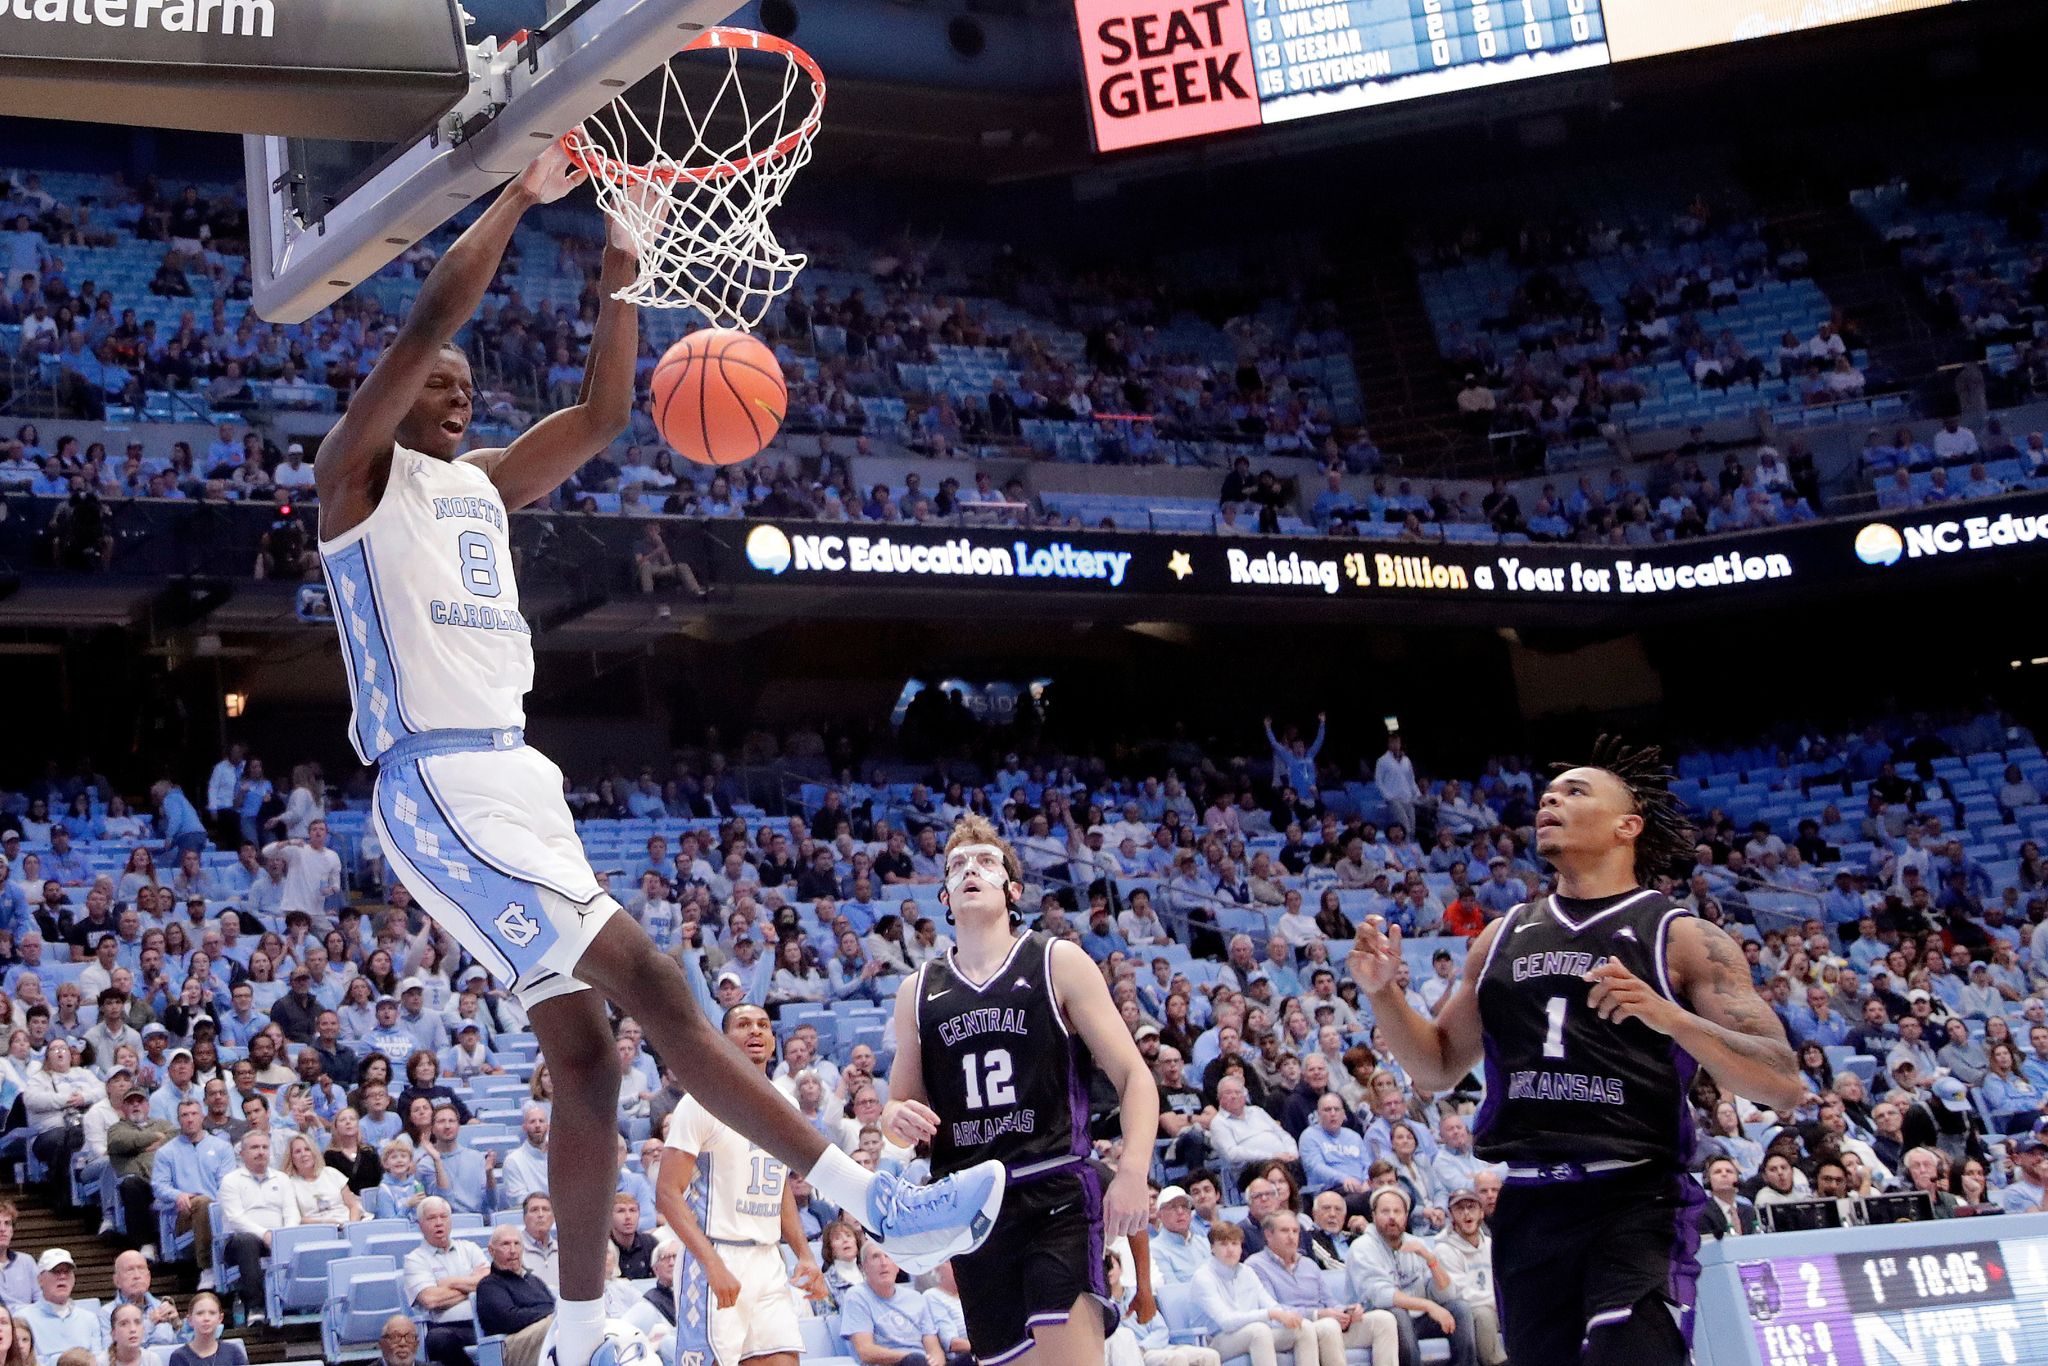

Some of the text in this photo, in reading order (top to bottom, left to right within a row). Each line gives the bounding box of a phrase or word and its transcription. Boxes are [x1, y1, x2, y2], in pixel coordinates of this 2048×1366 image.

[1098, 0, 1230, 66] SEAT
[1255, 18, 1273, 42] 8
[1279, 3, 1350, 39] WILSON
[1257, 43, 1281, 69] 13
[1283, 28, 1362, 64] VEESAAR
[1471, 4, 1492, 32] 2
[1260, 14, 1590, 95] 15 STEVENSON 0 0 0 0
[1099, 51, 1250, 119] GEEK
[433, 496, 504, 534] NORTH
[1903, 521, 1964, 559] NC
[458, 530, 502, 598] 8
[792, 535, 1132, 587] NC Education Lottery
[1226, 548, 1793, 595] Raising $1 Billion a Year for Education
[938, 1007, 1028, 1047] CENTRAL
[1543, 996, 1567, 1059] 1
[962, 1048, 1017, 1110] 12
[747, 1156, 784, 1196] 15
[1798, 1261, 1828, 1309] 2
[1906, 1250, 1989, 1298] 18:05
